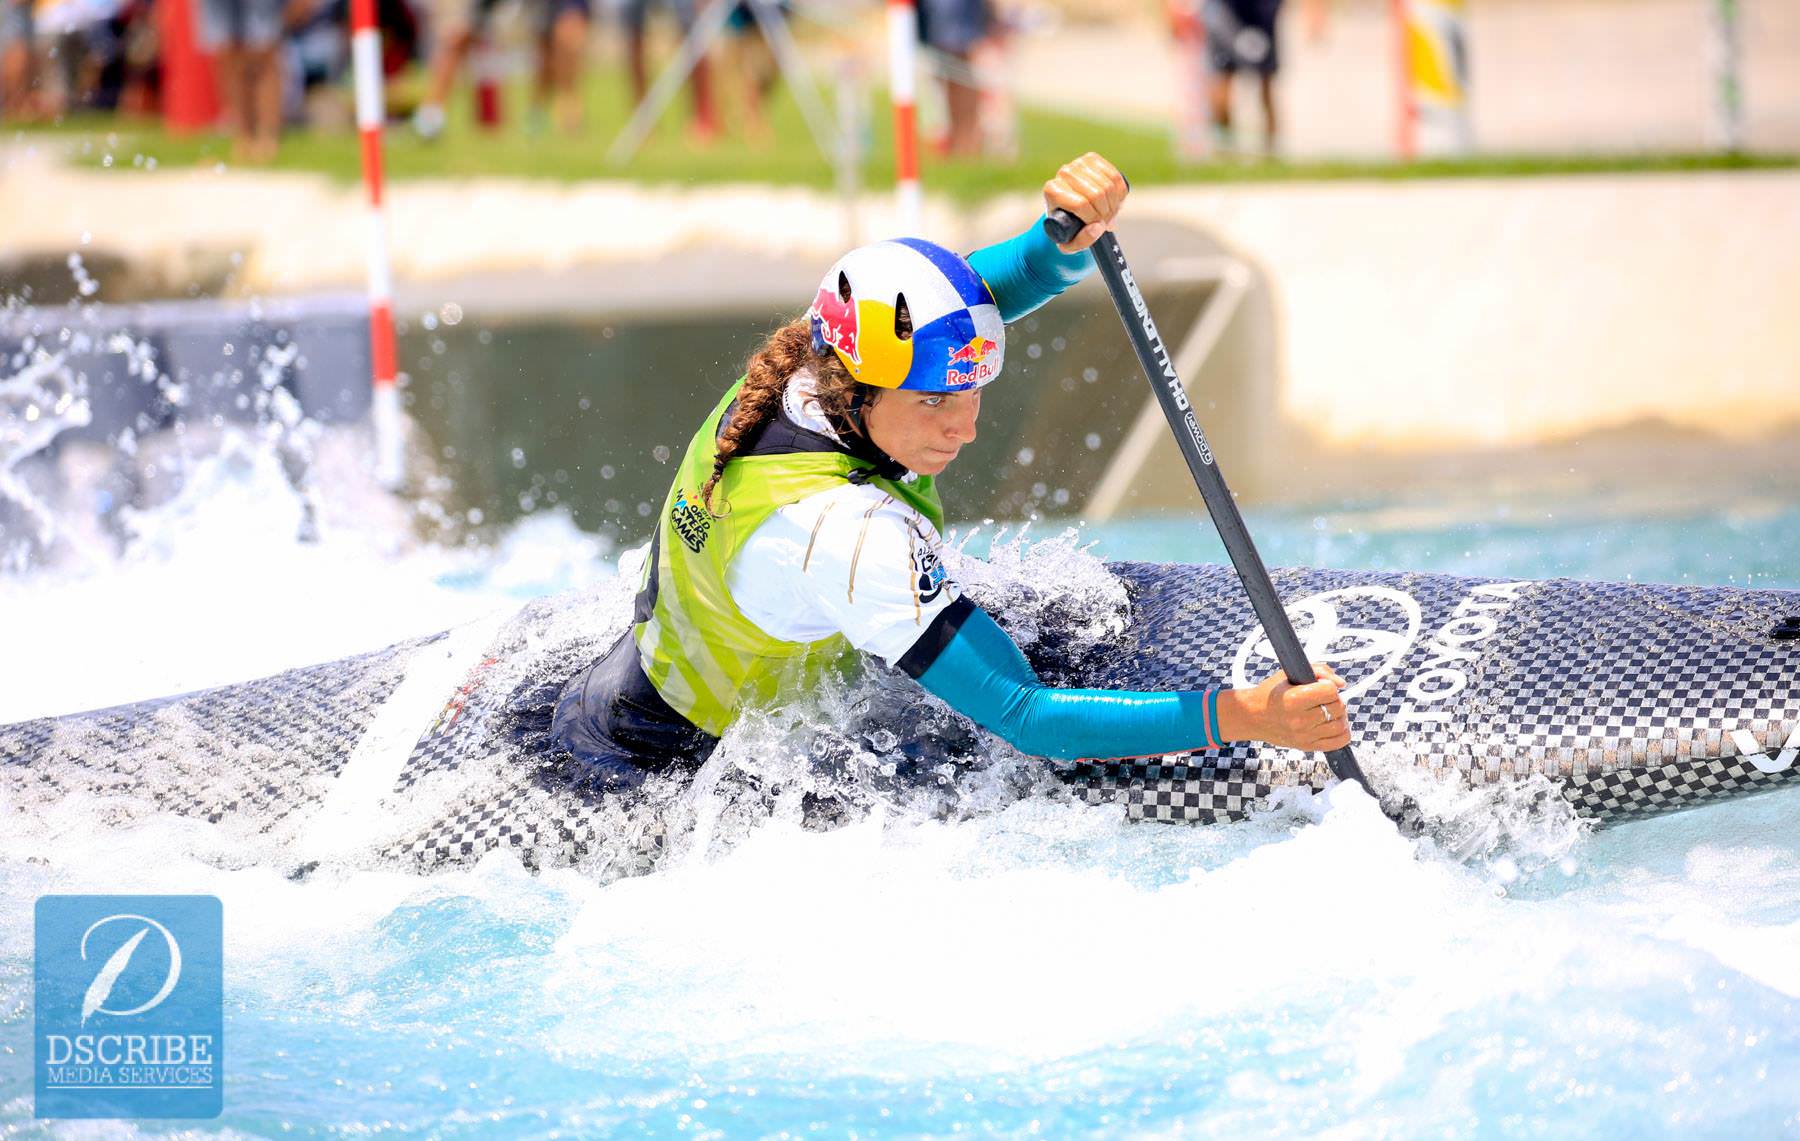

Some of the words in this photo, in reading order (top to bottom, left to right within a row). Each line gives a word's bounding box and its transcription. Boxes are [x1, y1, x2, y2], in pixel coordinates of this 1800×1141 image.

[946, 365, 978, 385] Red
[979, 356, 999, 378] Bull
[1120, 267, 1189, 412] CHALLENGER
[671, 508, 704, 553] GAMES
[1391, 581, 1532, 735] TOYOTA
